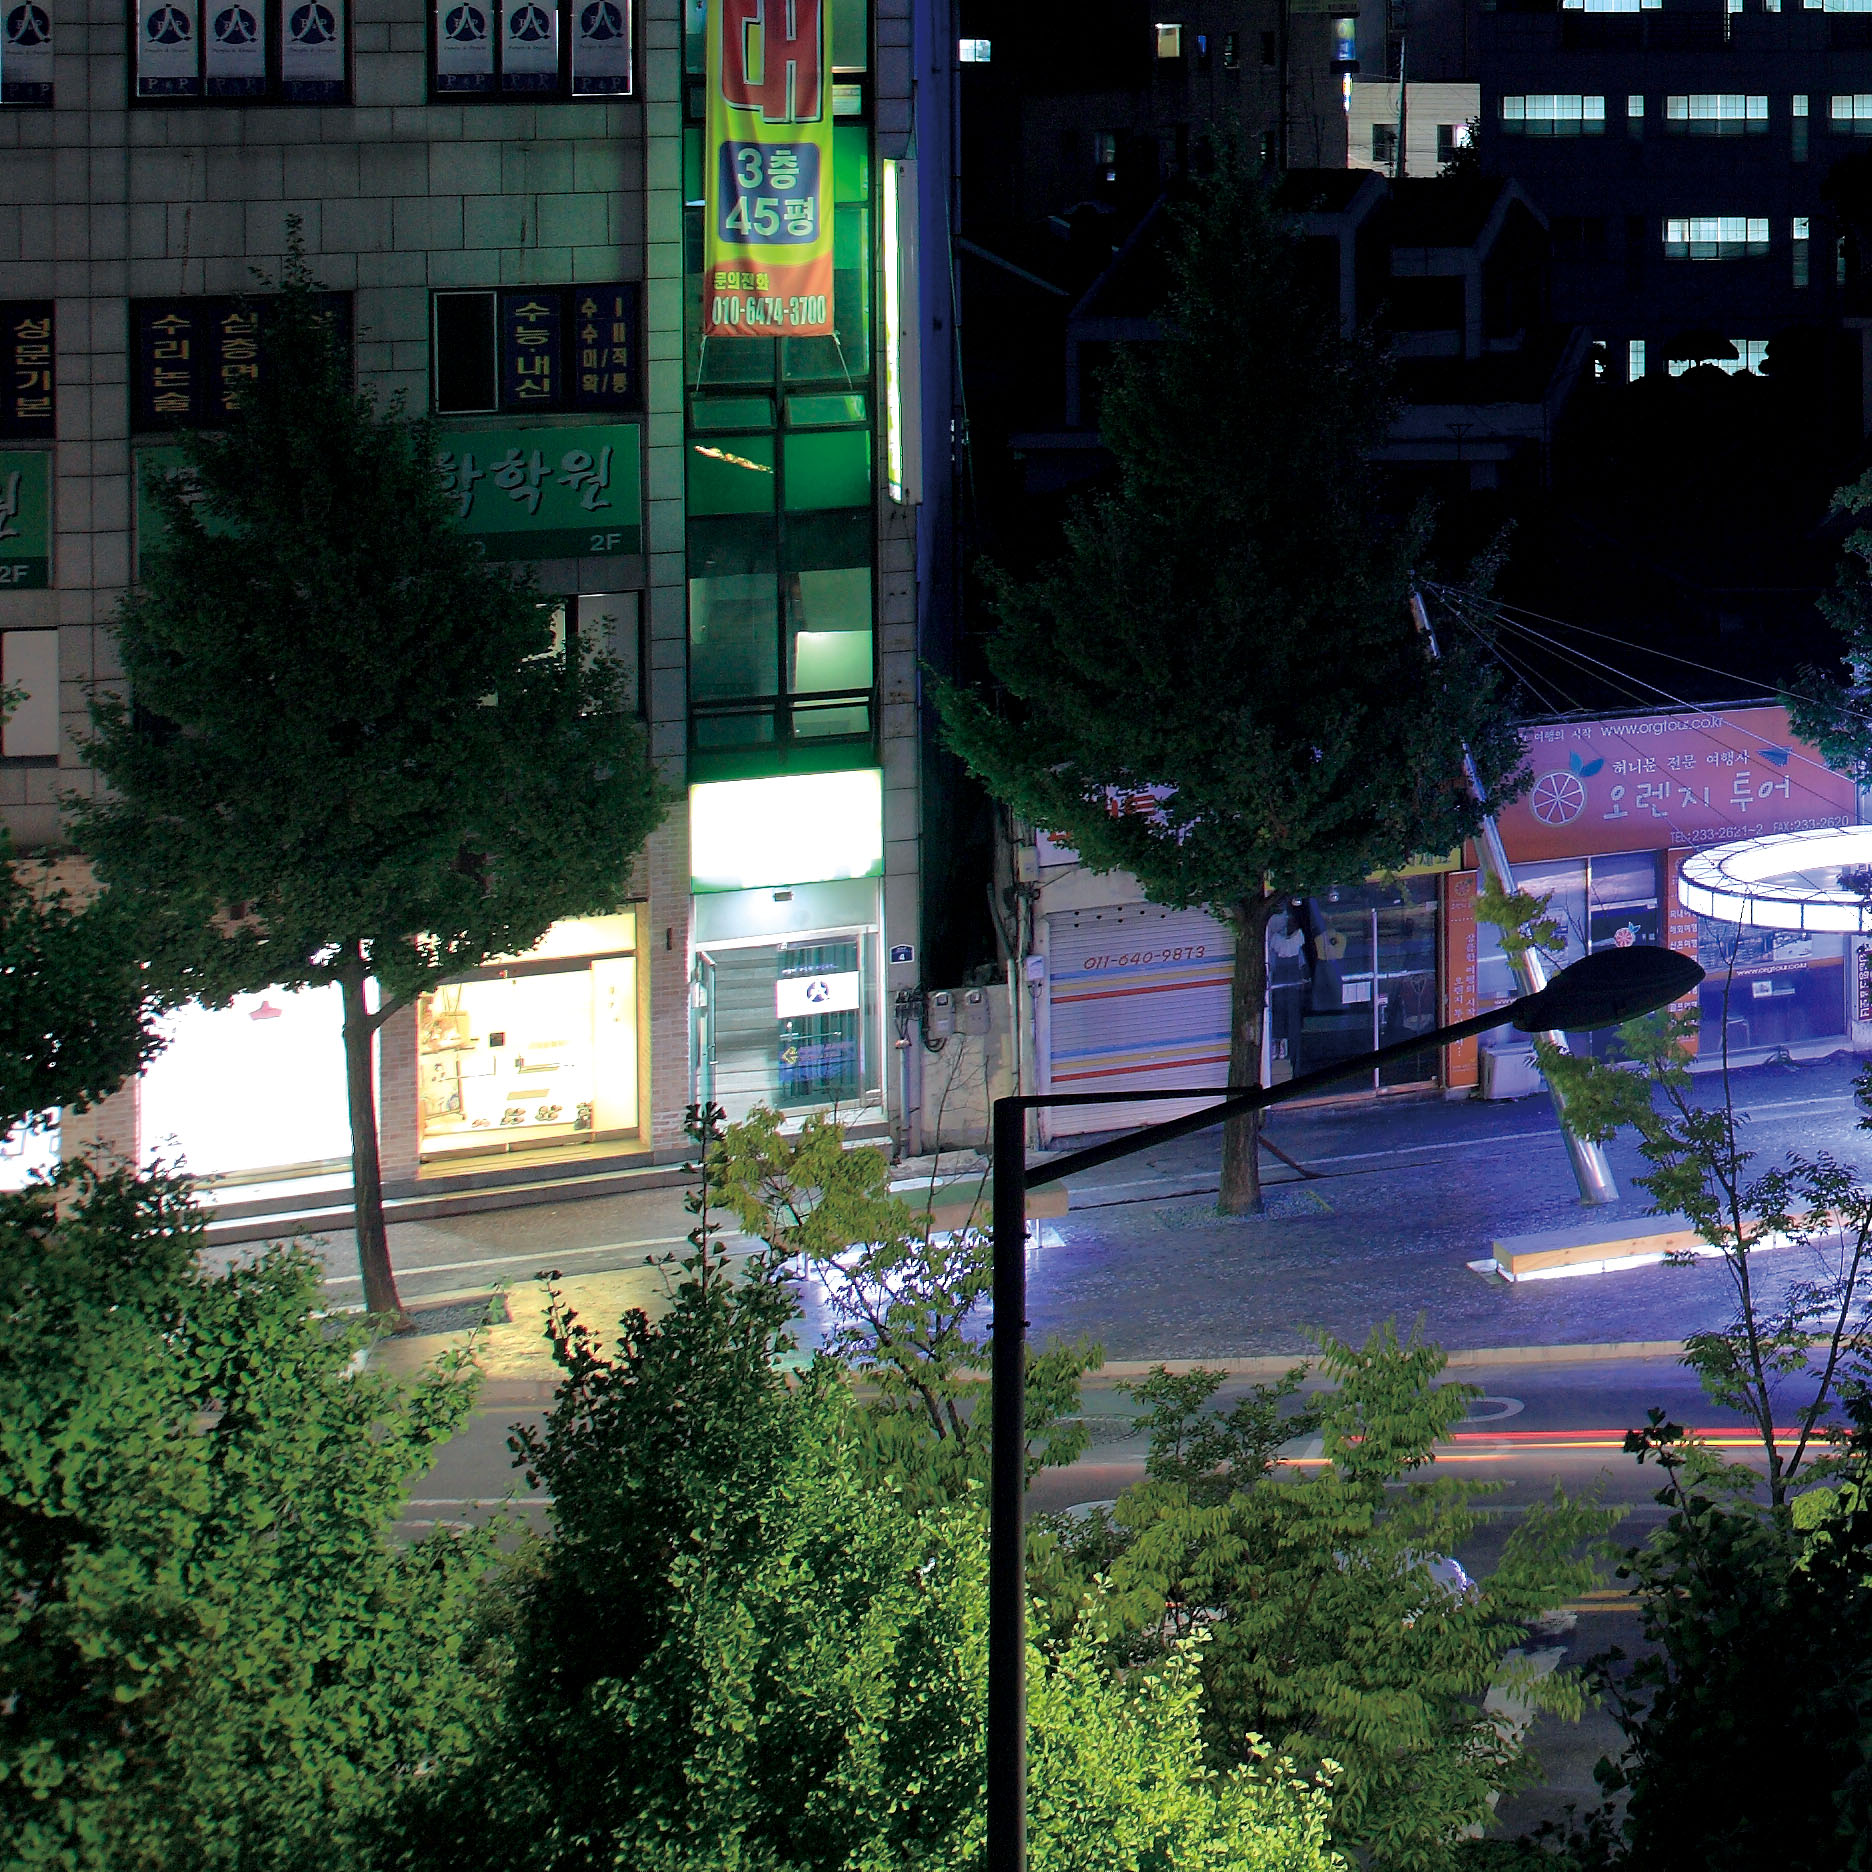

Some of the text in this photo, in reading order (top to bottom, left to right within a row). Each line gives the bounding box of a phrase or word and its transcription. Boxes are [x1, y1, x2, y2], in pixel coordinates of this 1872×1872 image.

[737, 148, 799, 190] 3층
[725, 195, 815, 237] 45평
[714, 271, 769, 292] 문의전화
[712, 295, 827, 327] 010-6474-3700
[151, 313, 192, 412] 수리논술
[590, 532, 621, 552] 2F
[1612, 749, 1750, 776] 허니문 전문 여행사
[1602, 771, 1791, 821] 오렌지 투어
[1084, 945, 1205, 970] 011-640-9873
